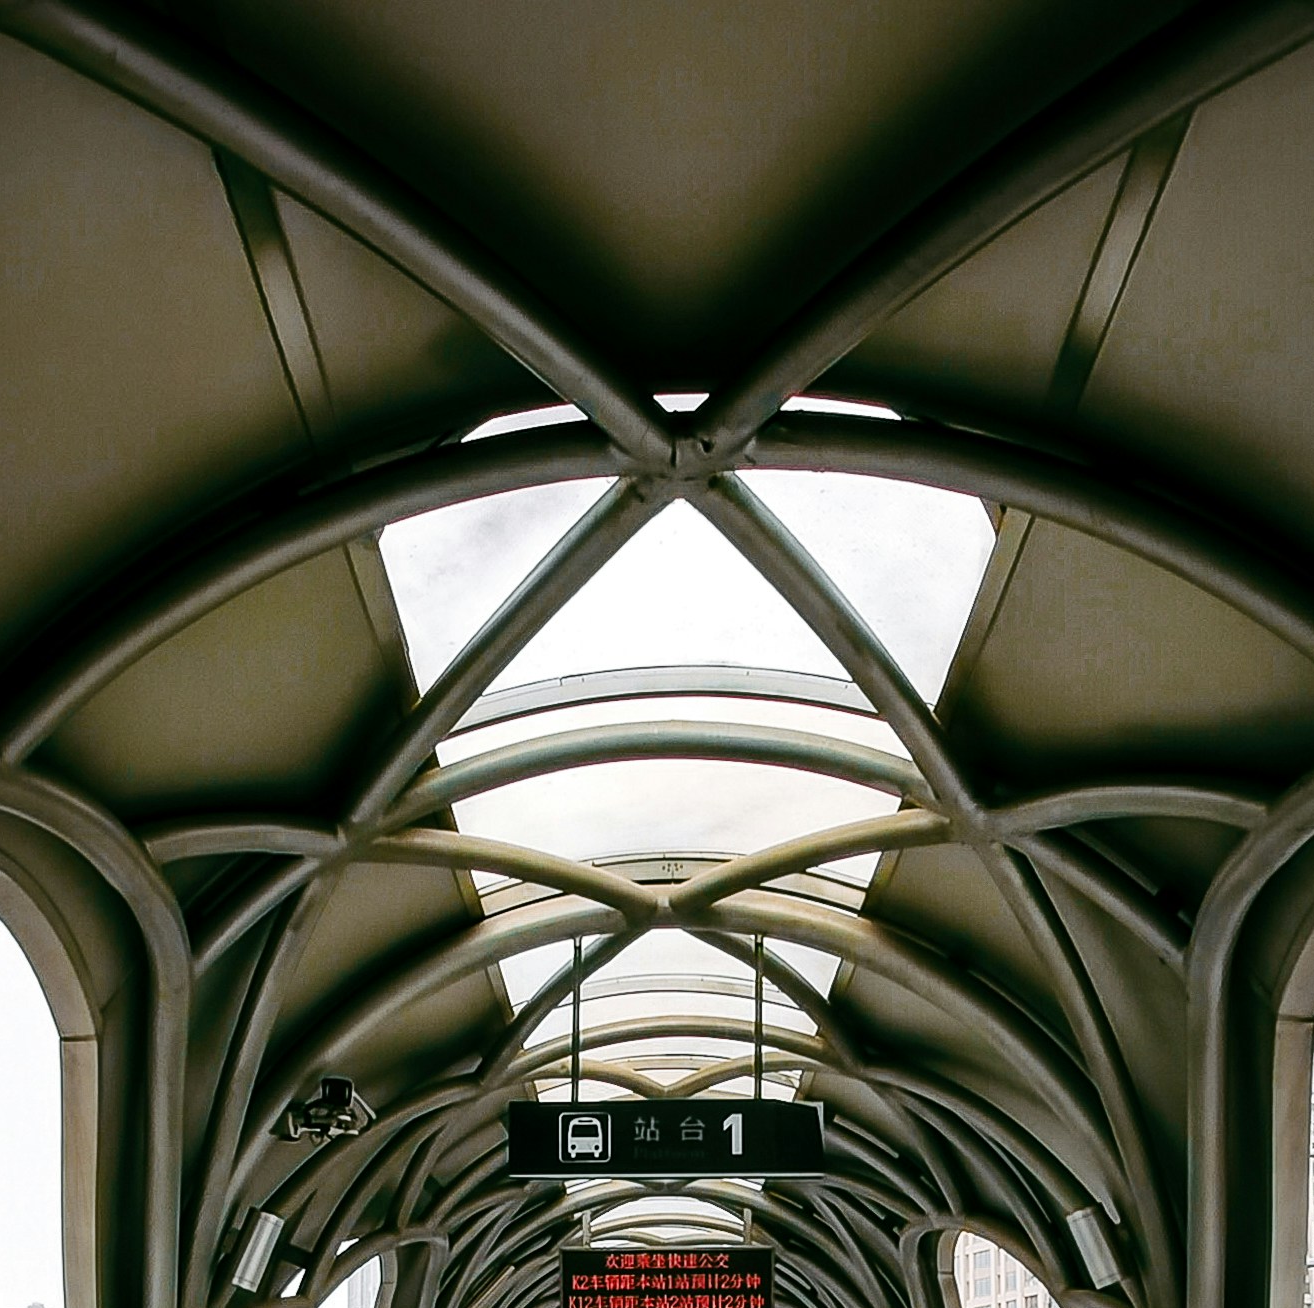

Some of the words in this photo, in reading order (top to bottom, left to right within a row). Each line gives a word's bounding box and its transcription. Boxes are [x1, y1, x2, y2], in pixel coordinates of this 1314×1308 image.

[634, 1116, 706, 1142] 站台
[723, 1113, 743, 1155] 1
[605, 1253, 730, 1269] 欢迎乘坐快速公交
[572, 1273, 762, 1291] K2车辆距本站1站预计2分钟
